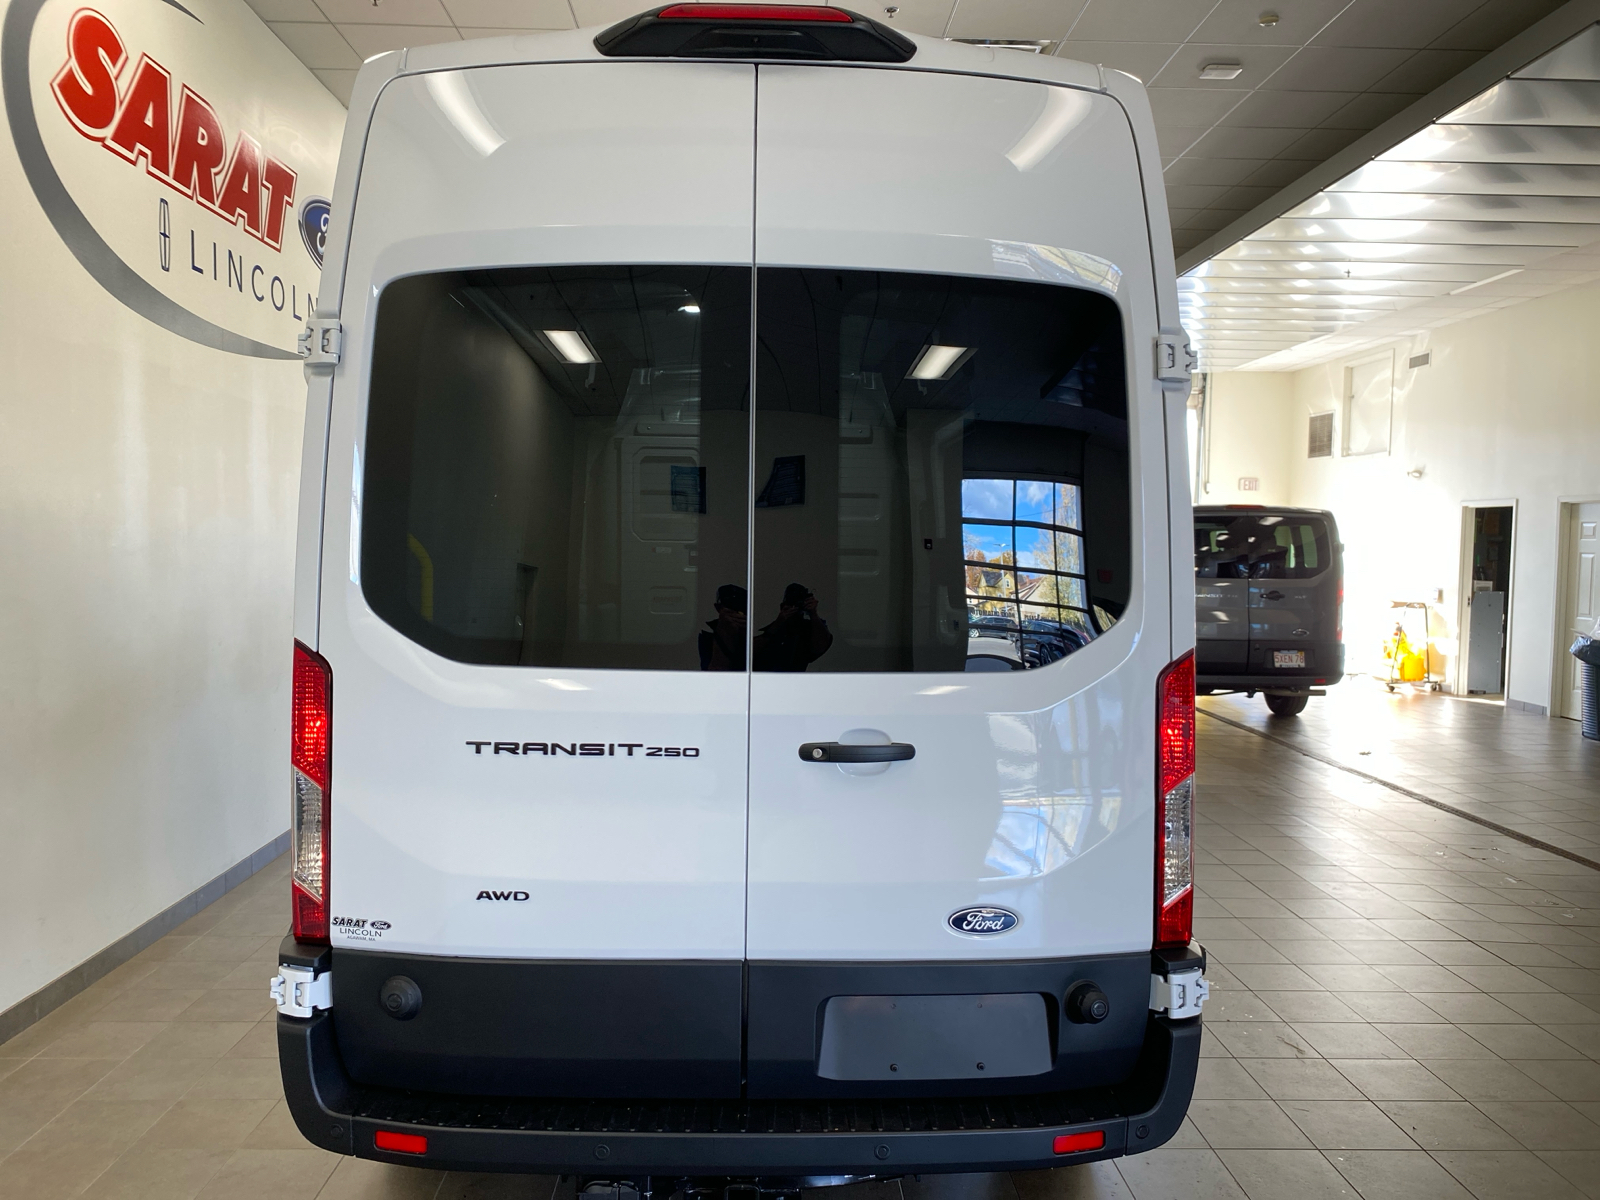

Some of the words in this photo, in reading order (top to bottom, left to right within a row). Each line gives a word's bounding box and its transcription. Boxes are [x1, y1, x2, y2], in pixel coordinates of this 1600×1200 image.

[50, 7, 297, 253] SARAT
[1243, 479, 1258, 491] EXIT
[1274, 654, 1293, 663] 5XEN
[466, 741, 643, 756] TRANSIT
[646, 747, 700, 757] 250
[476, 890, 530, 901] AWD
[332, 916, 368, 928] SARAT
[962, 912, 1005, 930] Ford
[340, 927, 382, 937] LINCOLN
